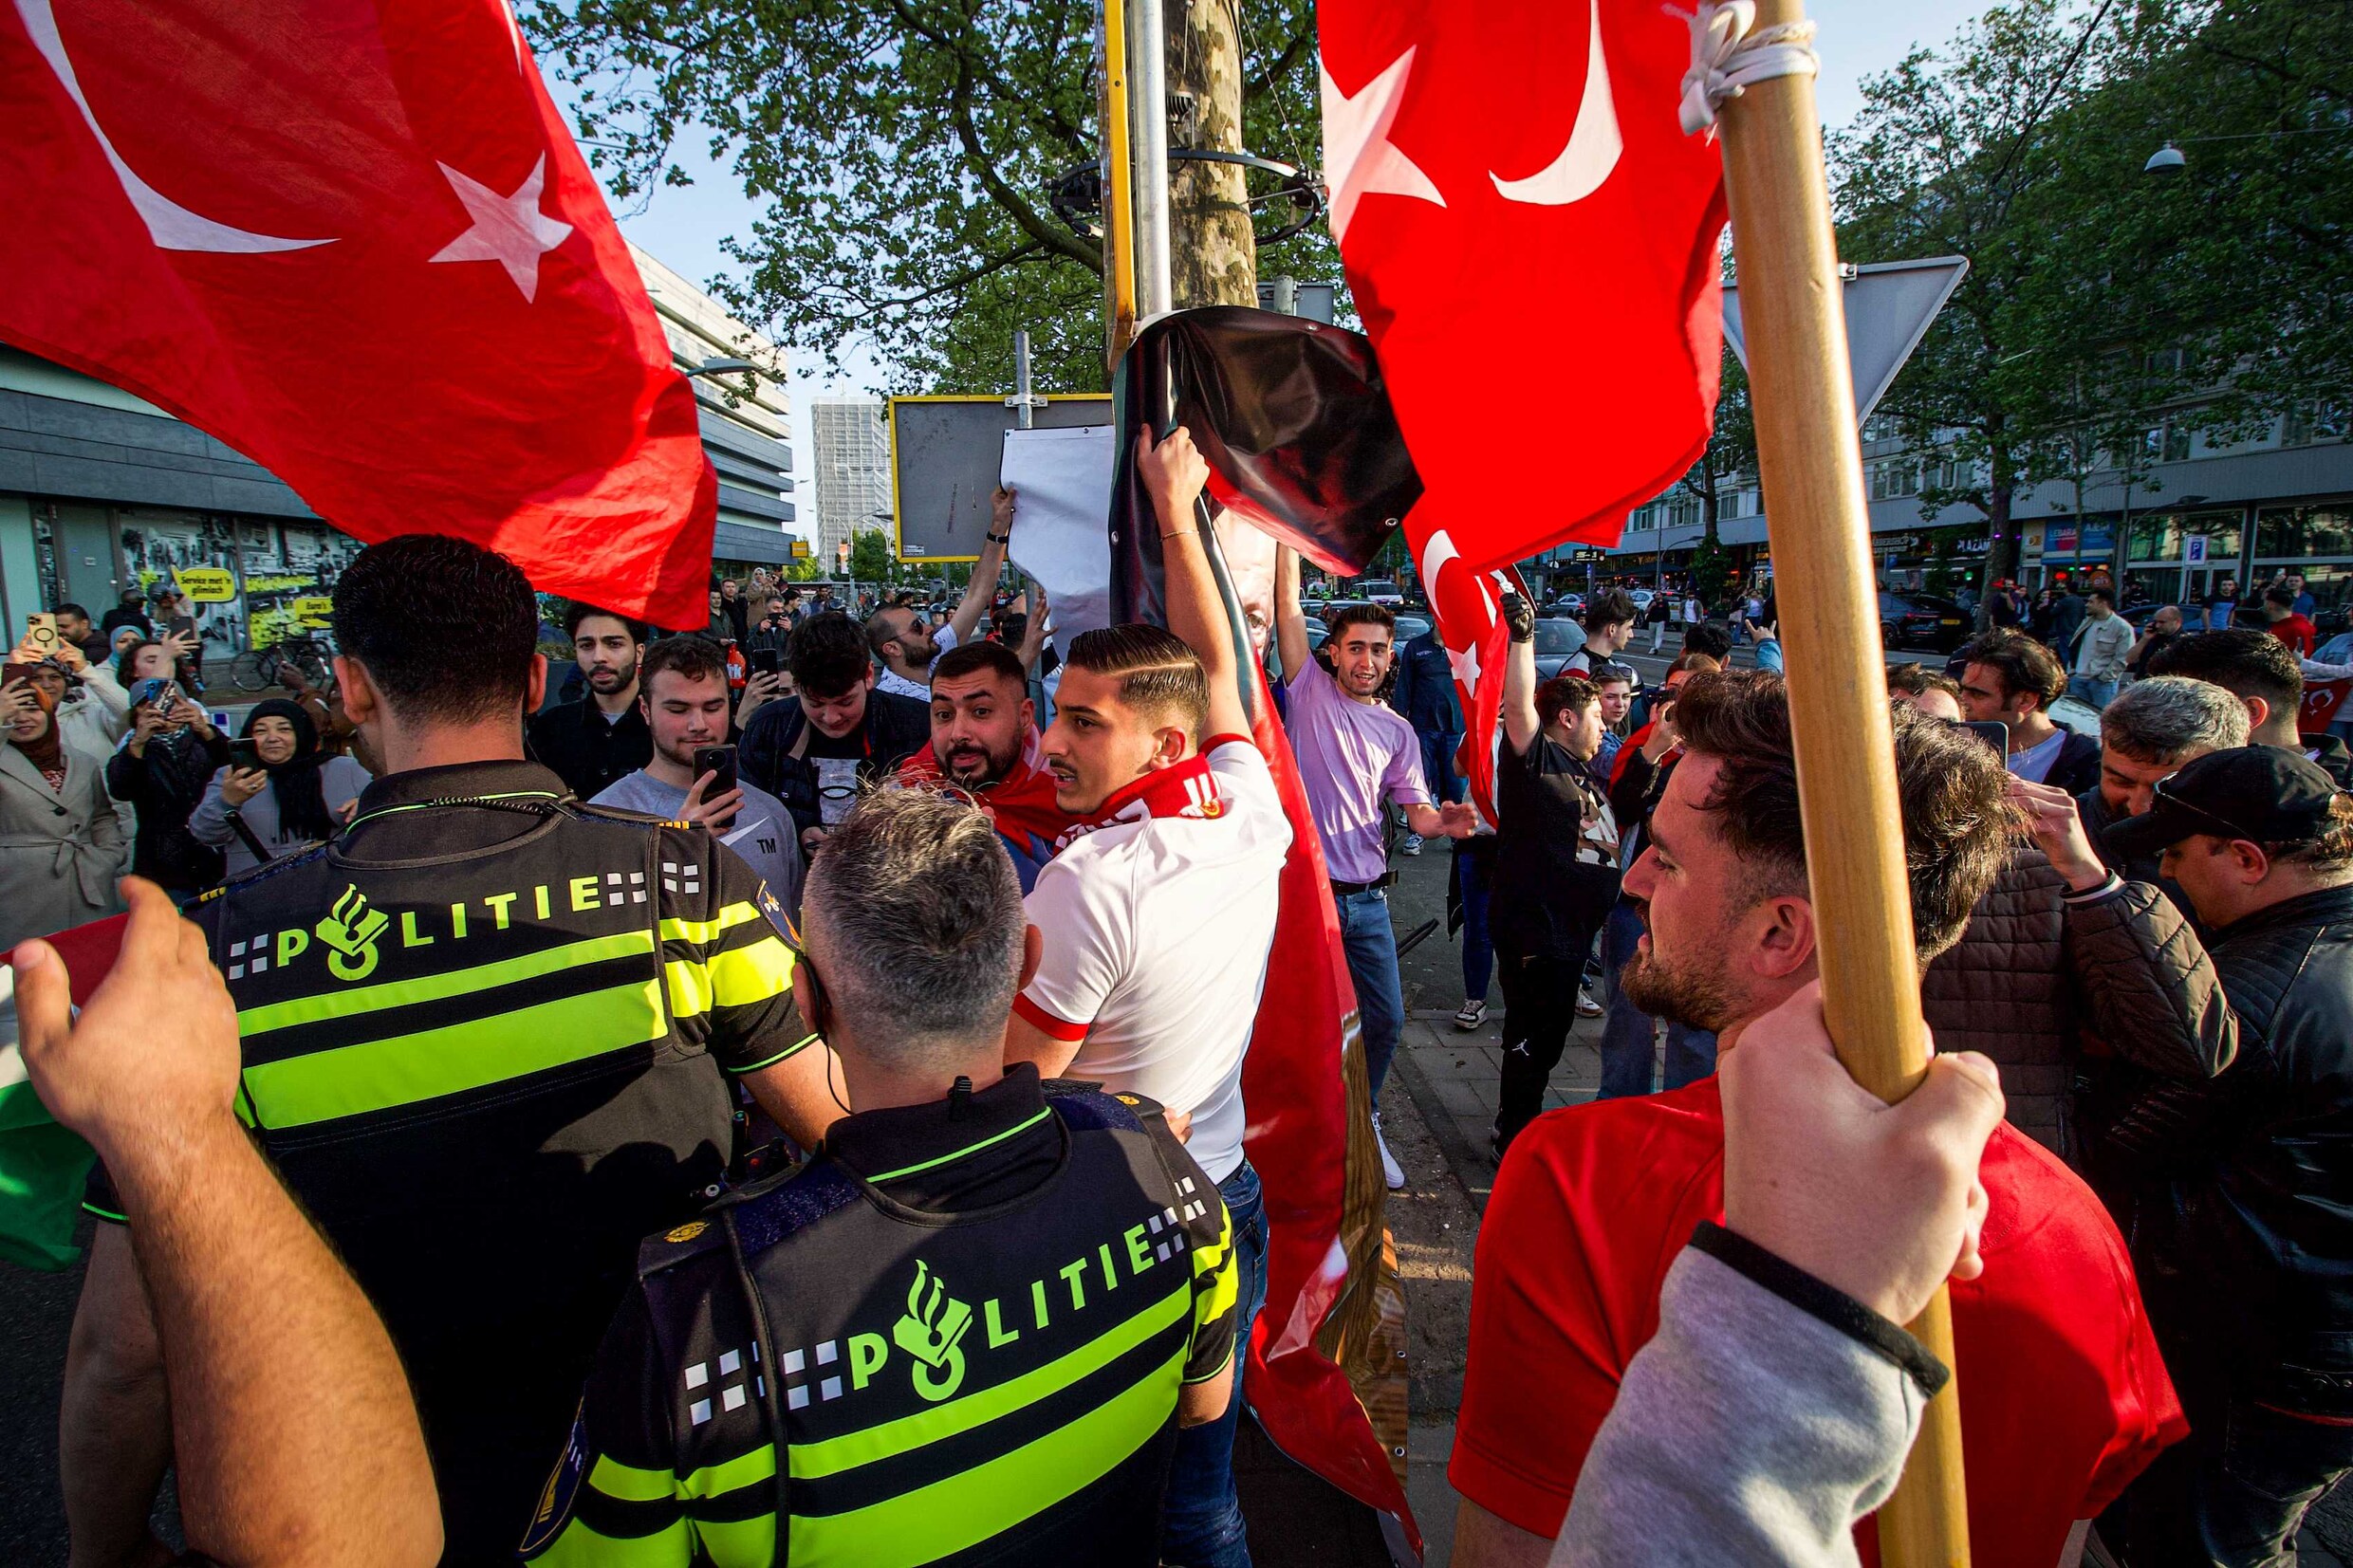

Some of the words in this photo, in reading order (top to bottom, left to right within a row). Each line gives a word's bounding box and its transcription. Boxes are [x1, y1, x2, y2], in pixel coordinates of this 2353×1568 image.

[2194, 543, 2200, 552] P
[180, 576, 206, 584] Service
[208, 576, 223, 584] met
[192, 585, 223, 596] glimlach
[756, 838, 777, 854] TM
[276, 876, 602, 981] POLITIE
[847, 1223, 1155, 1401] POLITIE
